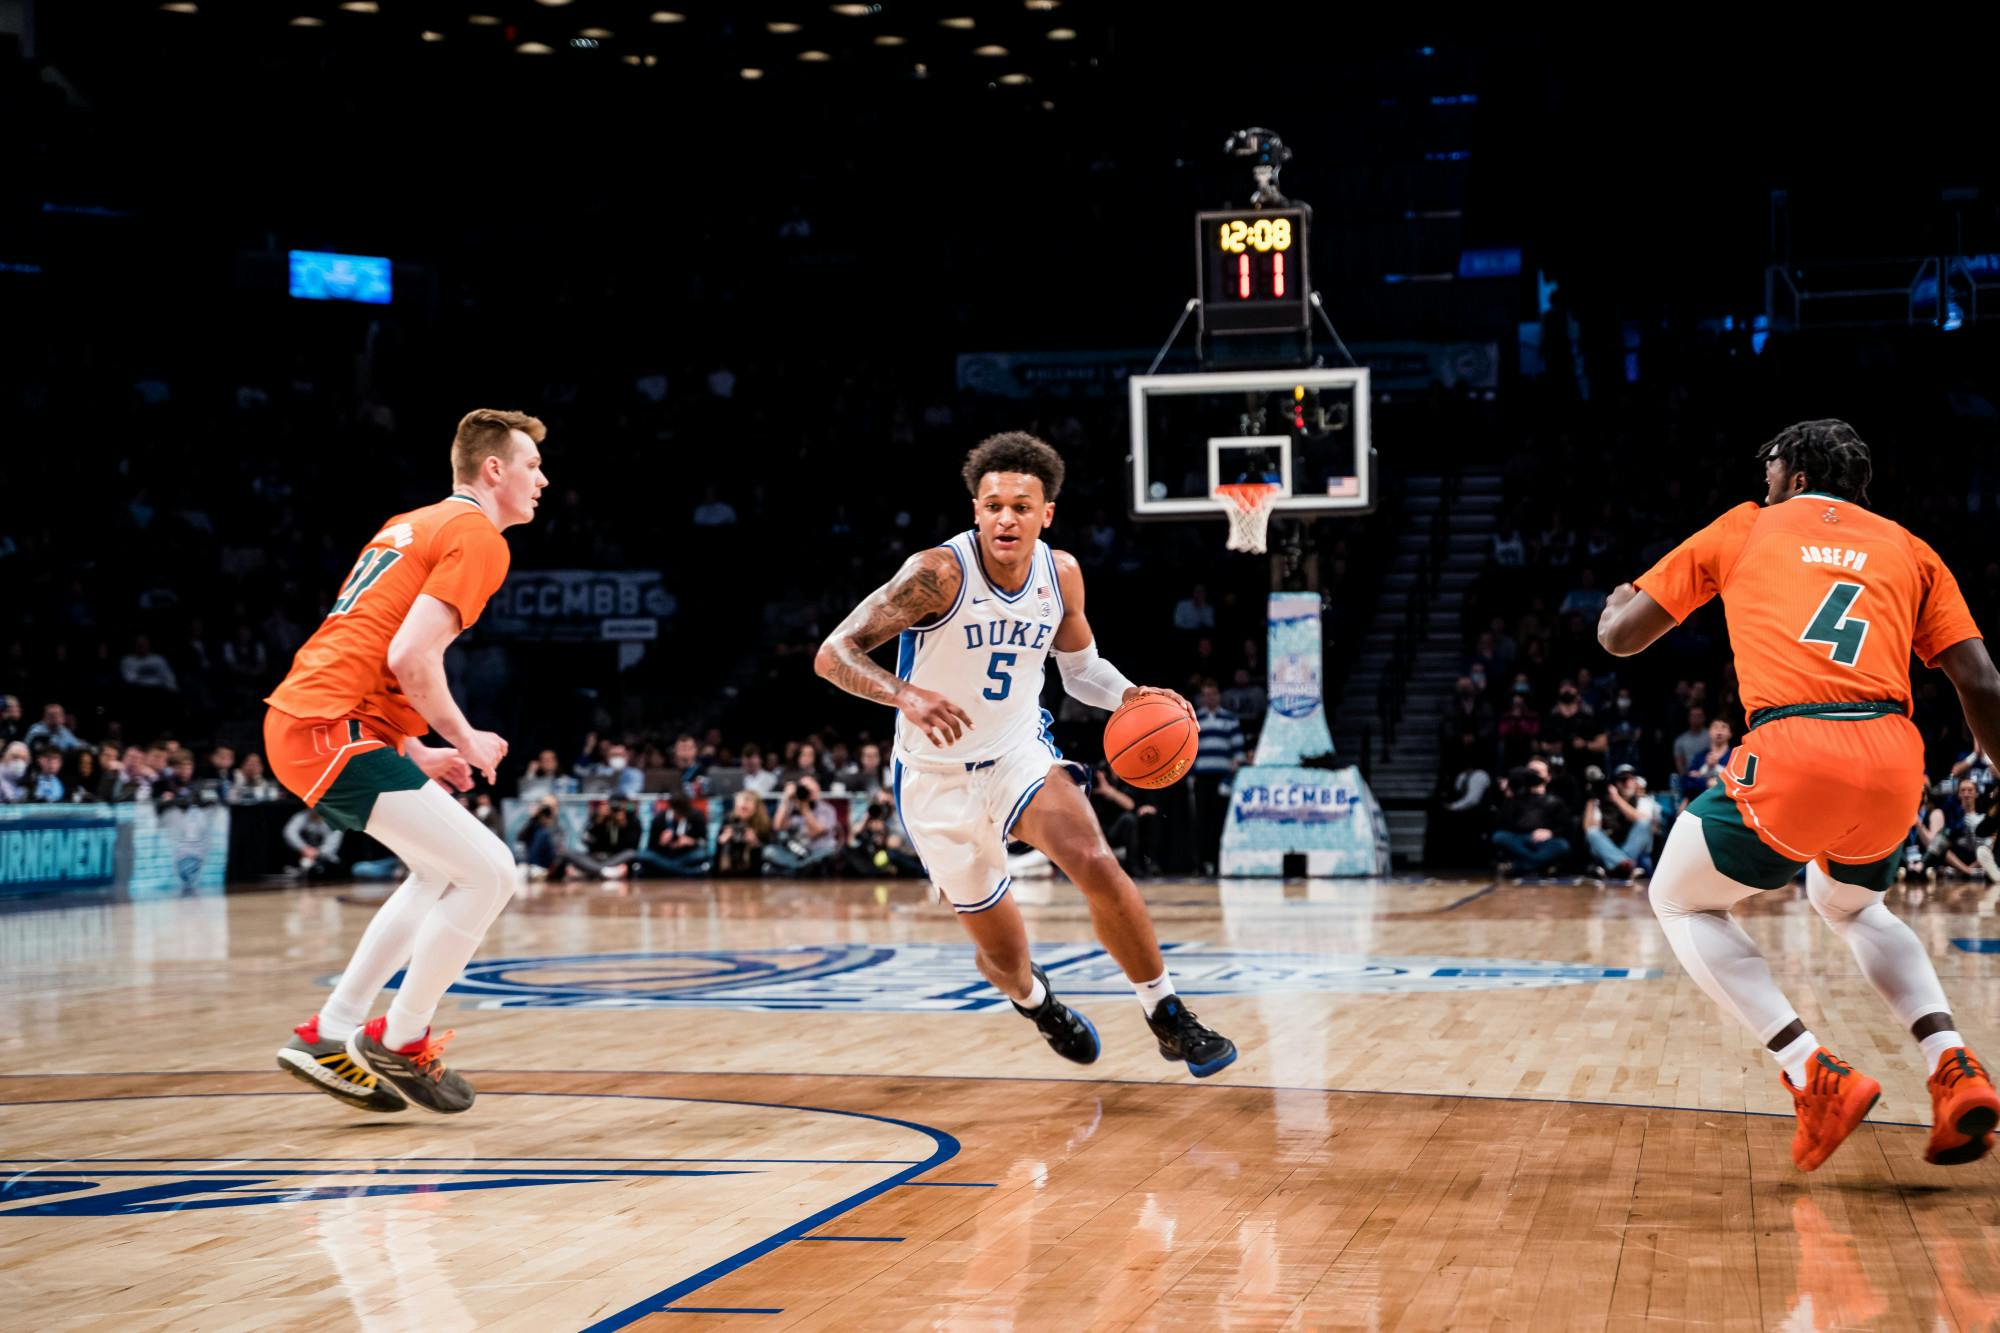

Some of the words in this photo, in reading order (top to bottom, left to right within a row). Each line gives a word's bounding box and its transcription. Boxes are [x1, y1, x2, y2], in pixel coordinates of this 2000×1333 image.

[1221, 218, 1292, 253] 12:08
[1239, 251, 1285, 299] 11
[327, 547, 405, 616] 21
[1800, 545, 1868, 572] JOSEPH
[963, 619, 1053, 650] DUKE
[1798, 580, 1870, 668] 4
[982, 651, 1018, 701] 5
